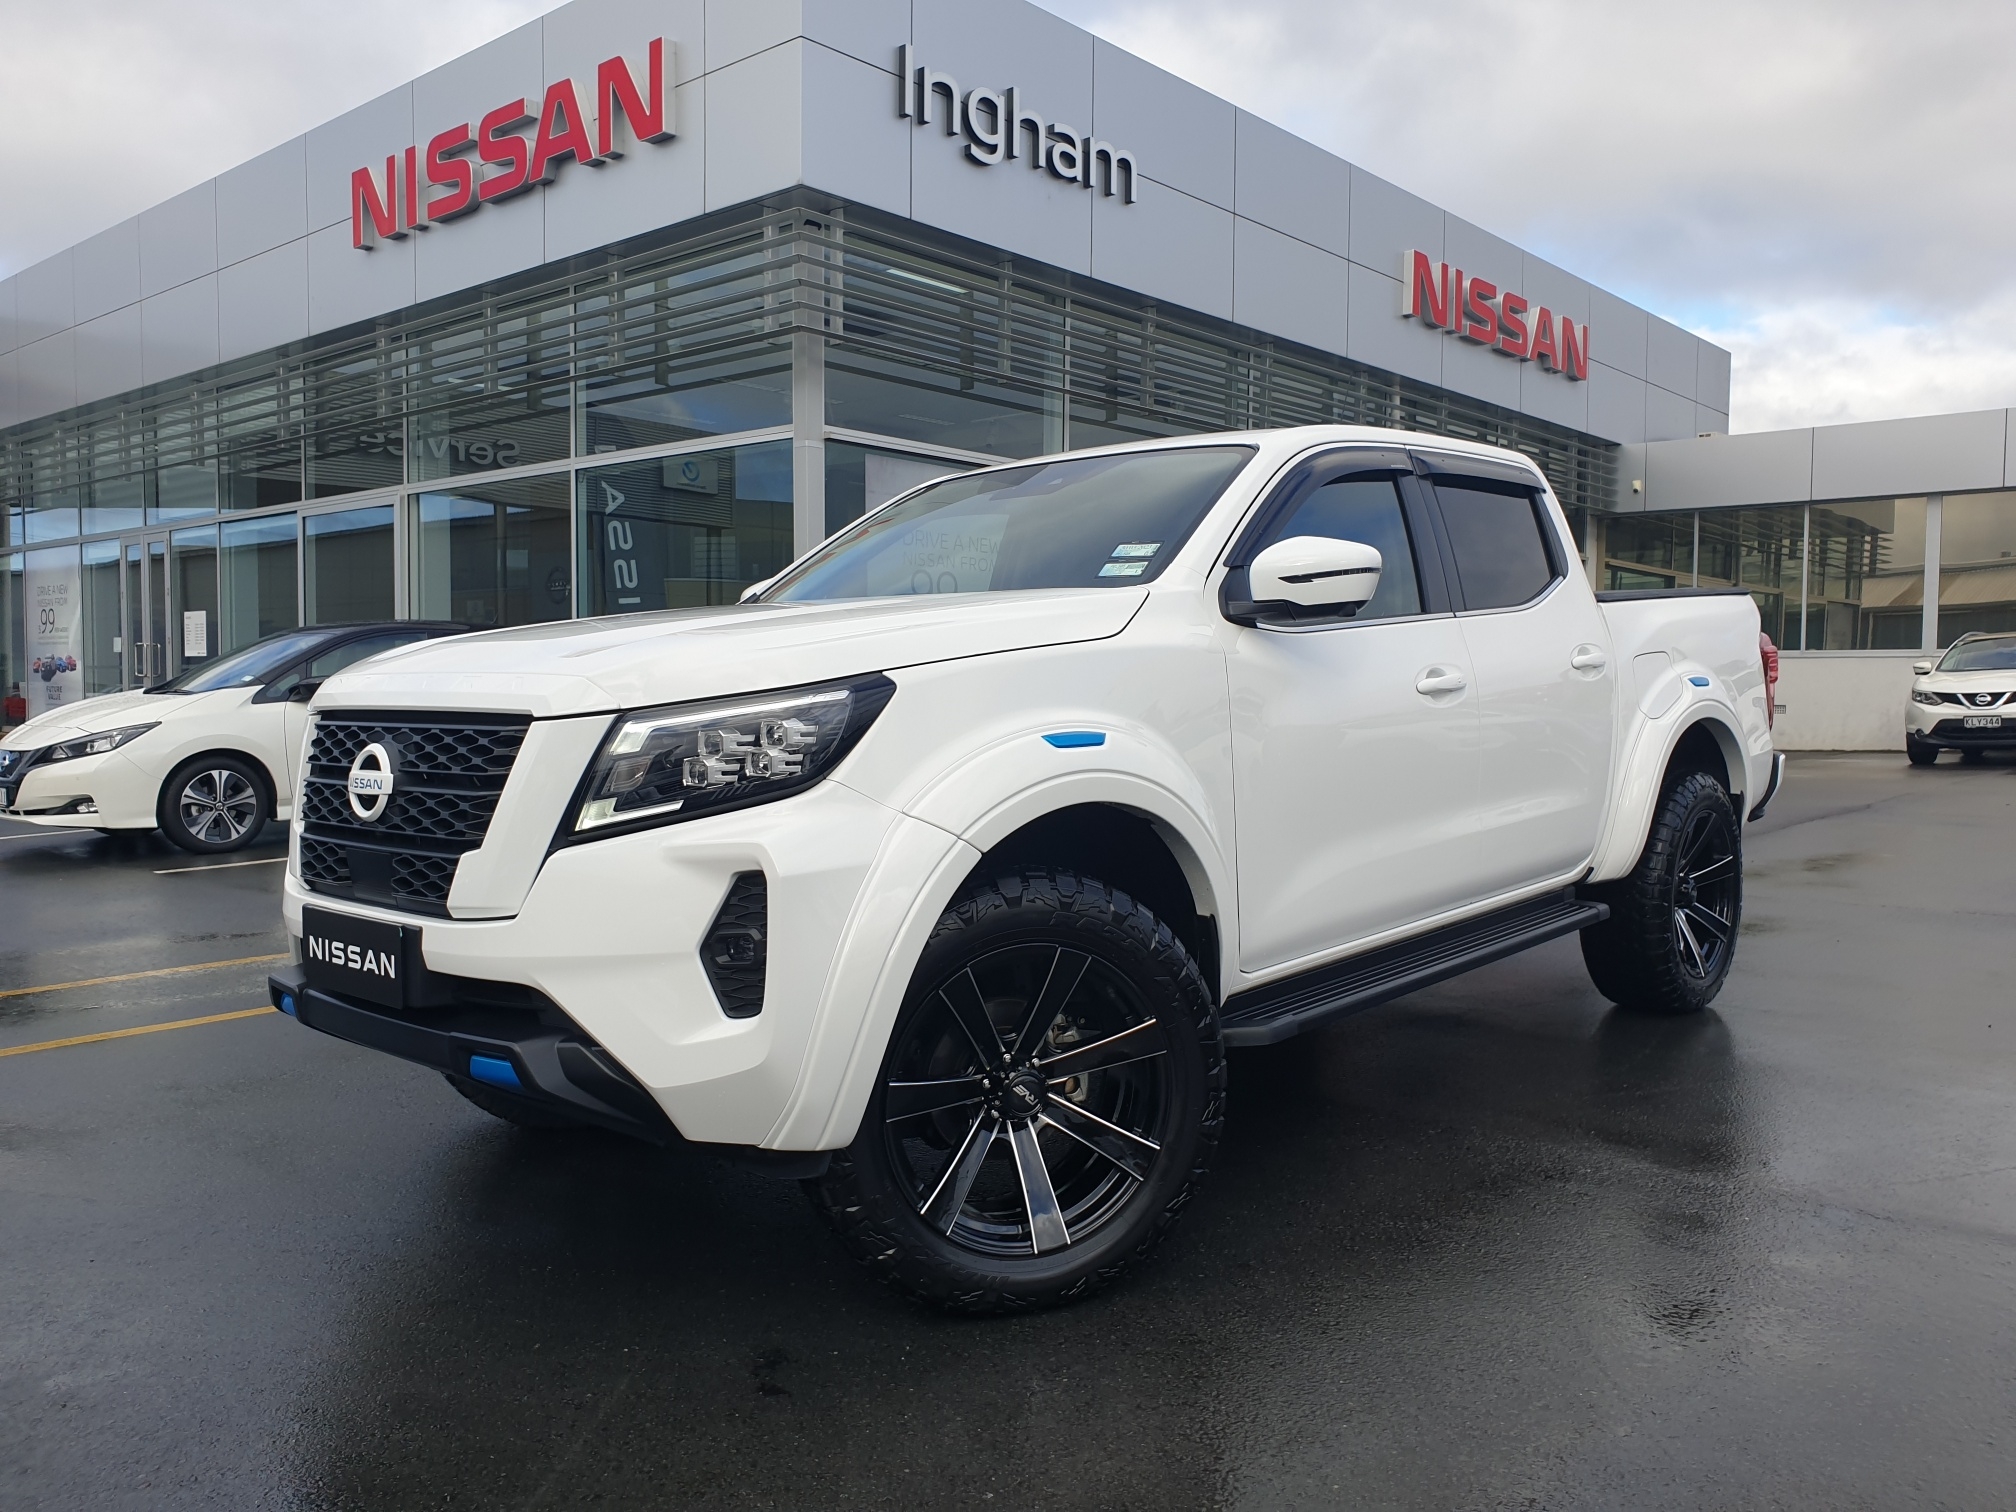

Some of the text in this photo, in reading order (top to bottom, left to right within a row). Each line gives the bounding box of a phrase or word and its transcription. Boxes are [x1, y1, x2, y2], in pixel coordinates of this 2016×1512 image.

[352, 36, 676, 250] NISSAN
[898, 43, 1138, 204] Ingham
[1402, 248, 1588, 381] NISSAN
[903, 551, 955, 569] NISSAN
[953, 534, 964, 551] A
[1965, 717, 2000, 726] KLY344
[309, 934, 396, 979] NISSAN
